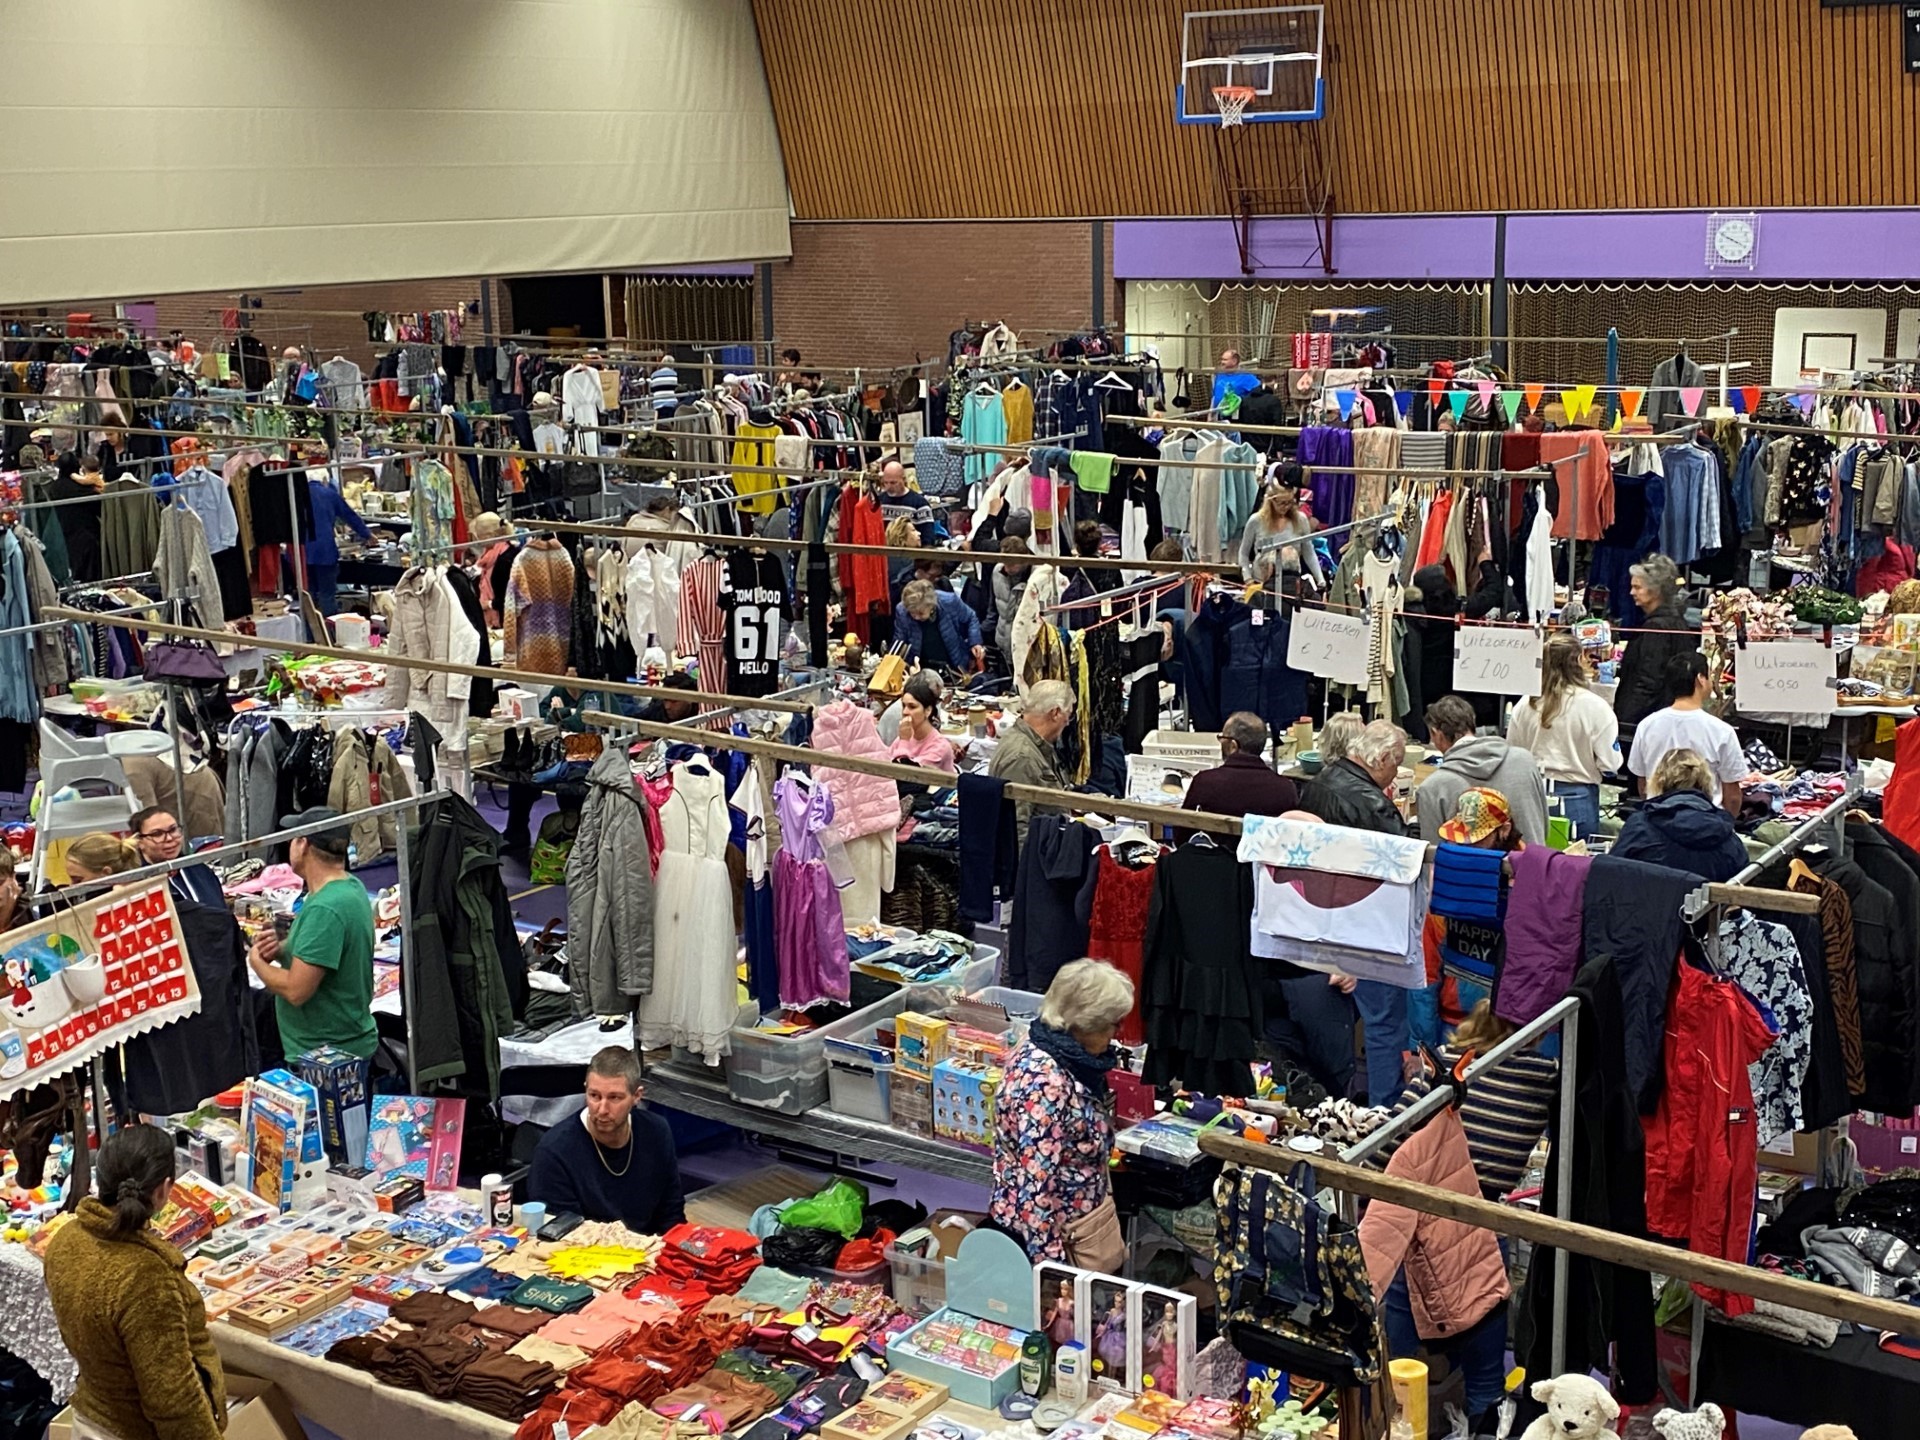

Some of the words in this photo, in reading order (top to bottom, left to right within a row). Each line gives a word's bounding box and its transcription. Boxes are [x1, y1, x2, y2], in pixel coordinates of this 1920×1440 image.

[735, 589, 753, 602] TOM
[734, 606, 780, 660] 61
[739, 662, 769, 674] HELLO
[101, 923, 107, 933] 4
[119, 919, 126, 929] 3
[136, 911, 145, 921] 2
[155, 903, 160, 912] 1
[1449, 917, 1501, 945] HAPPY
[106, 951, 114, 961] 8
[126, 944, 133, 954] 7
[145, 937, 153, 947] 6
[161, 930, 168, 940] 5
[1459, 940, 1491, 961] DAY
[111, 980, 121, 990] 12
[130, 971, 140, 982] 11
[148, 965, 158, 976] 10
[168, 958, 177, 968] 9
[33, 1051, 45, 1063] 22
[50, 1041, 59, 1054] 21
[102, 1013, 112, 1025] 17
[122, 1007, 132, 1018] 16
[137, 1000, 147, 1011] 15
[156, 993, 167, 1004] 14
[170, 986, 182, 998] 13
[7, 1043, 20, 1056] 23
